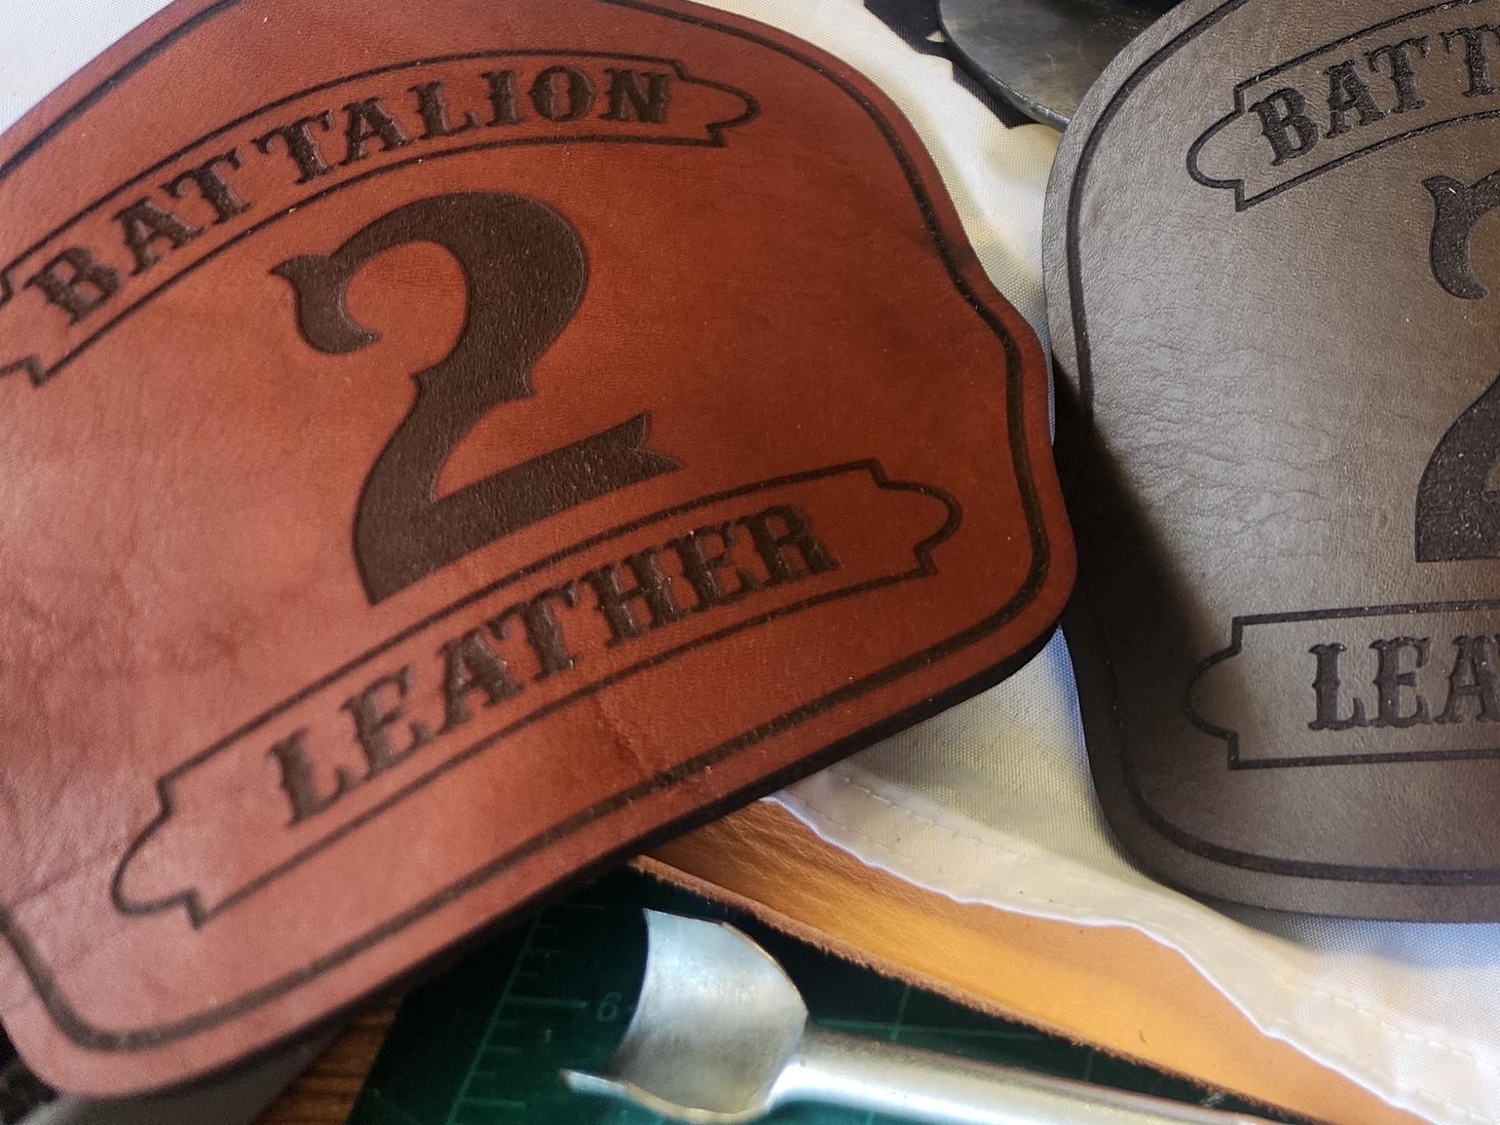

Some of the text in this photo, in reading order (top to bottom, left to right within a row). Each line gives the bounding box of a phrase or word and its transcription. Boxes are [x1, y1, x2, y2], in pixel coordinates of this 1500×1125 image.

[24, 65, 674, 327] BATTALION
[267, 191, 686, 606] 2
[268, 503, 838, 827] LEATHER
